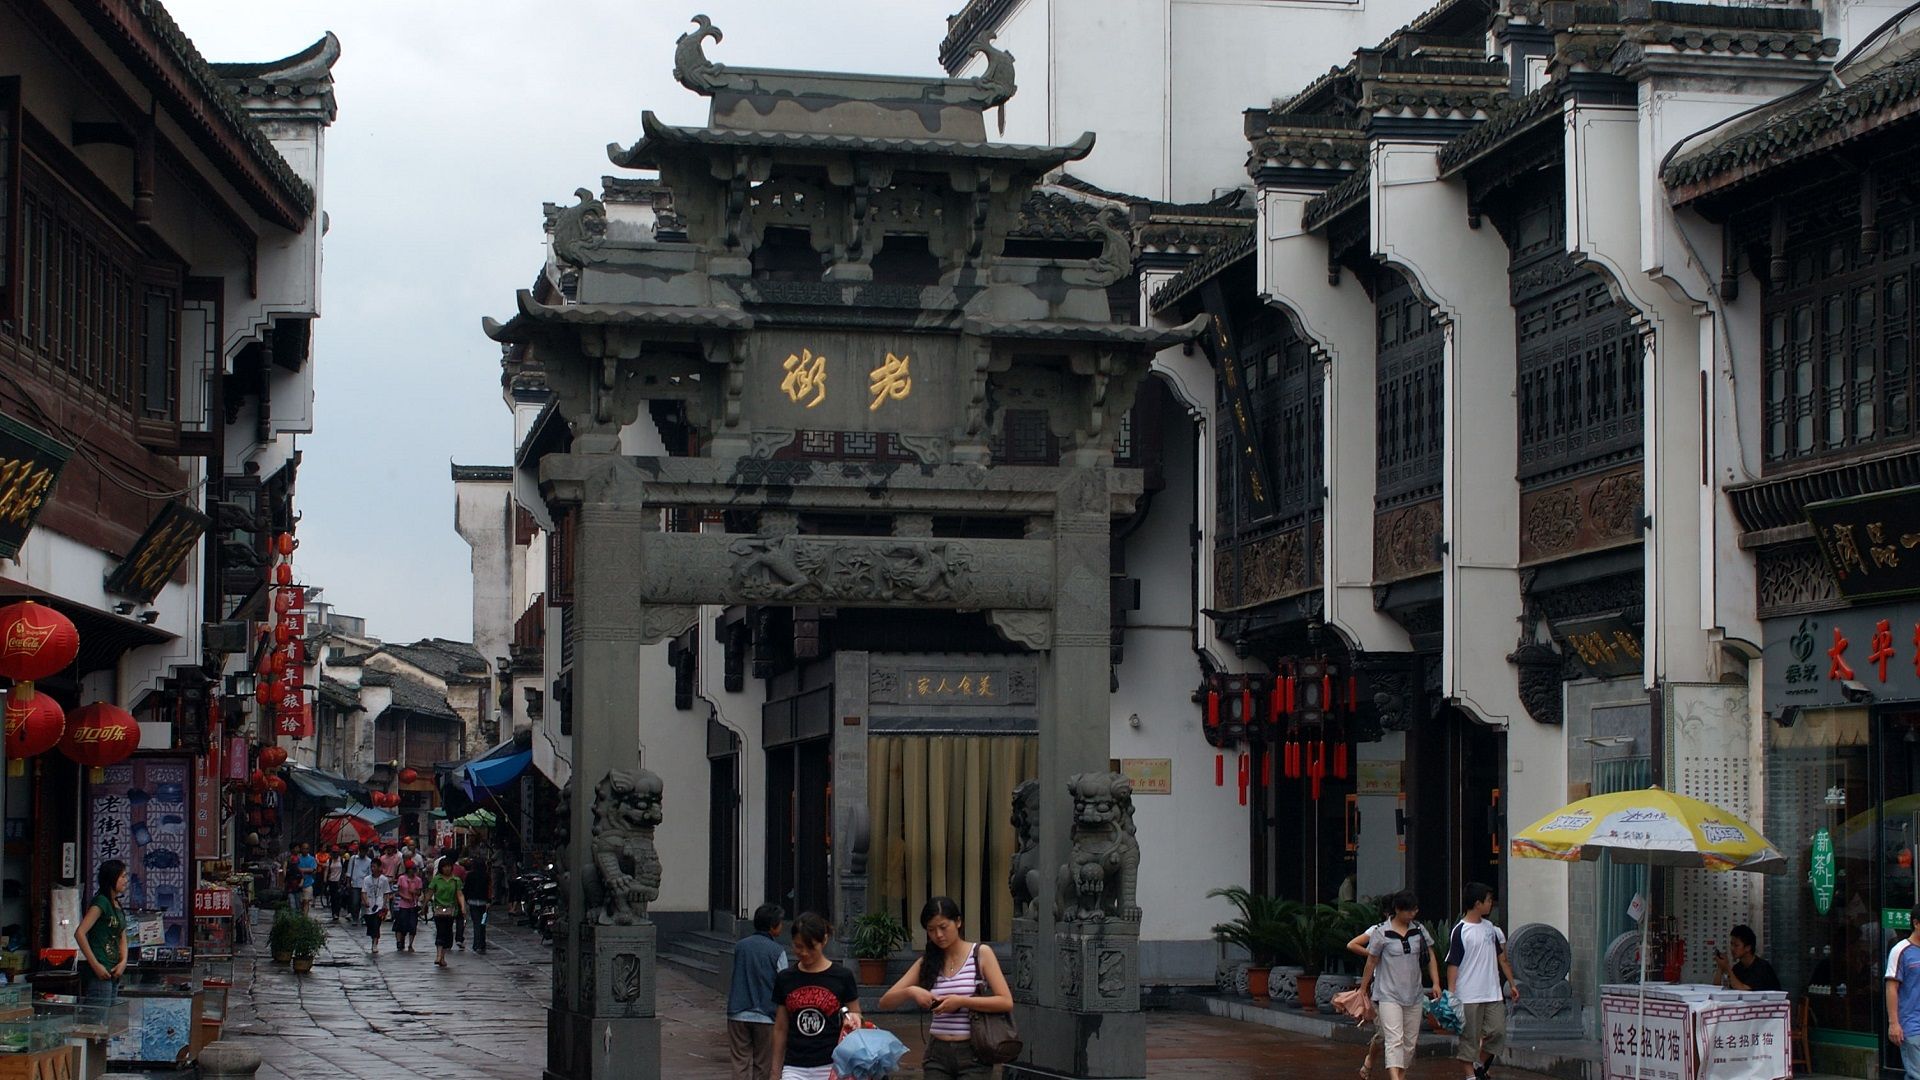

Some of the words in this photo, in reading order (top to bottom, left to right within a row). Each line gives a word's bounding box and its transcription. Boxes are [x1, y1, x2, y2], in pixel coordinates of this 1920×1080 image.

[1827, 618, 1920, 683] 太平
[74, 724, 127, 743] 可口可乐
[1814, 831, 1834, 911] 新茶上市
[195, 892, 230, 911] 印章雕刻
[1612, 1022, 1680, 1062] 姓名招财猫
[1713, 1032, 1774, 1049] 姓名招财猫
